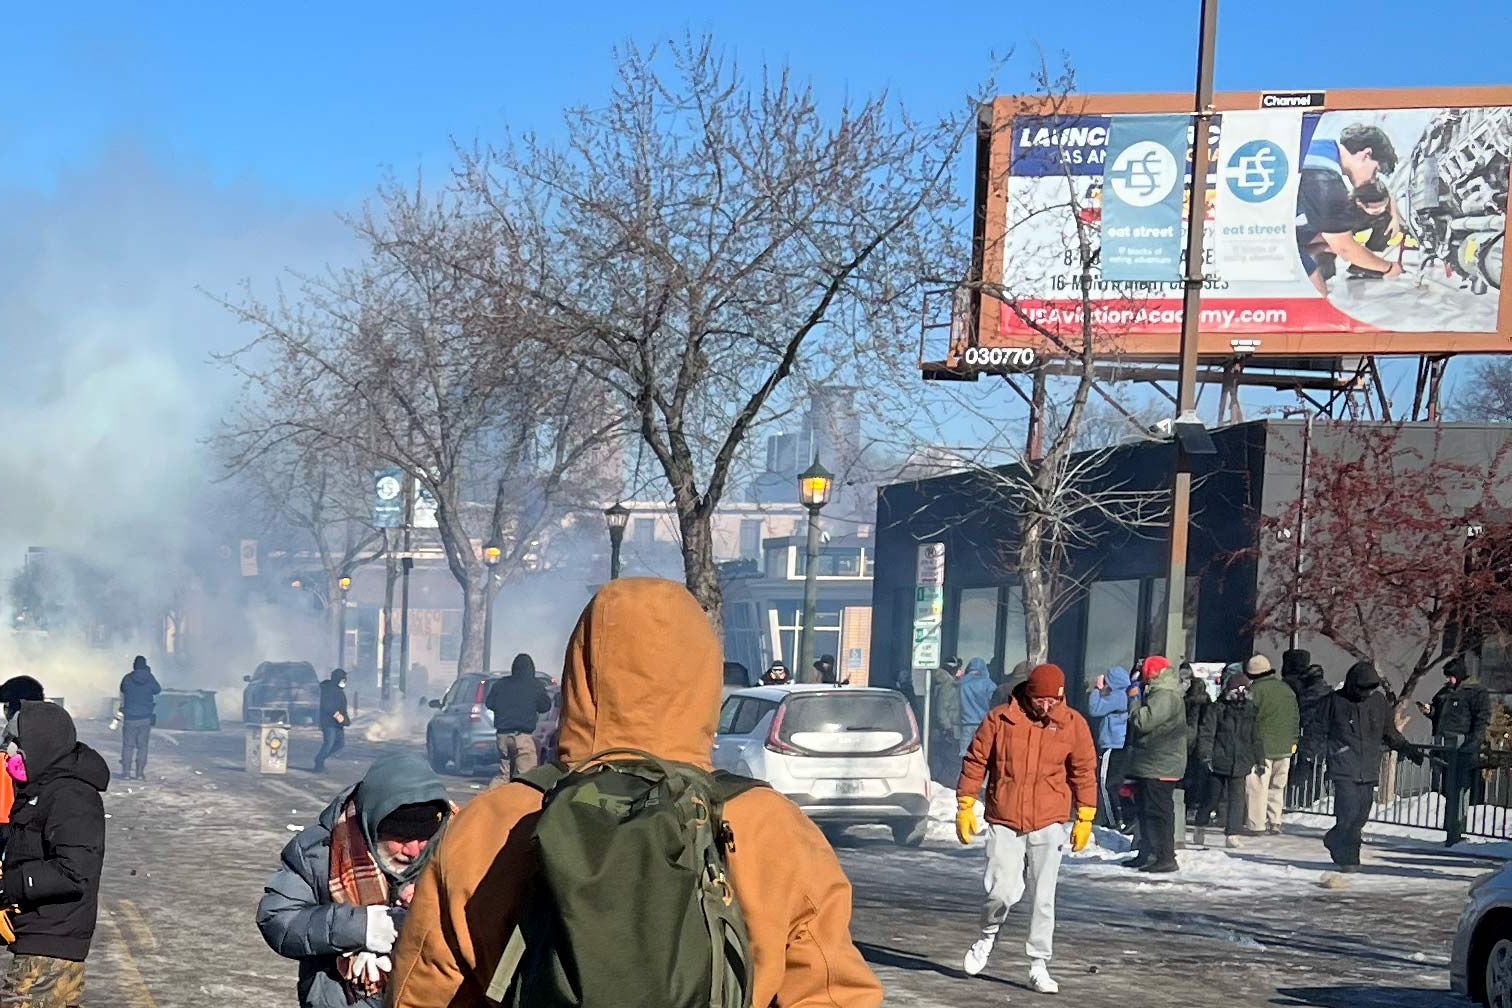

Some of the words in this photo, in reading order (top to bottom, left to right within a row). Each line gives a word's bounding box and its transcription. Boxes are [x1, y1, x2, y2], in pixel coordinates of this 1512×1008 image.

[1263, 95, 1311, 106] Channel
[1019, 127, 1111, 147] LAUNC
[1108, 226, 1130, 238] eat
[1133, 225, 1173, 238] street
[1223, 225, 1244, 235] eat
[1247, 224, 1287, 235] street
[965, 347, 1035, 365] 030770
